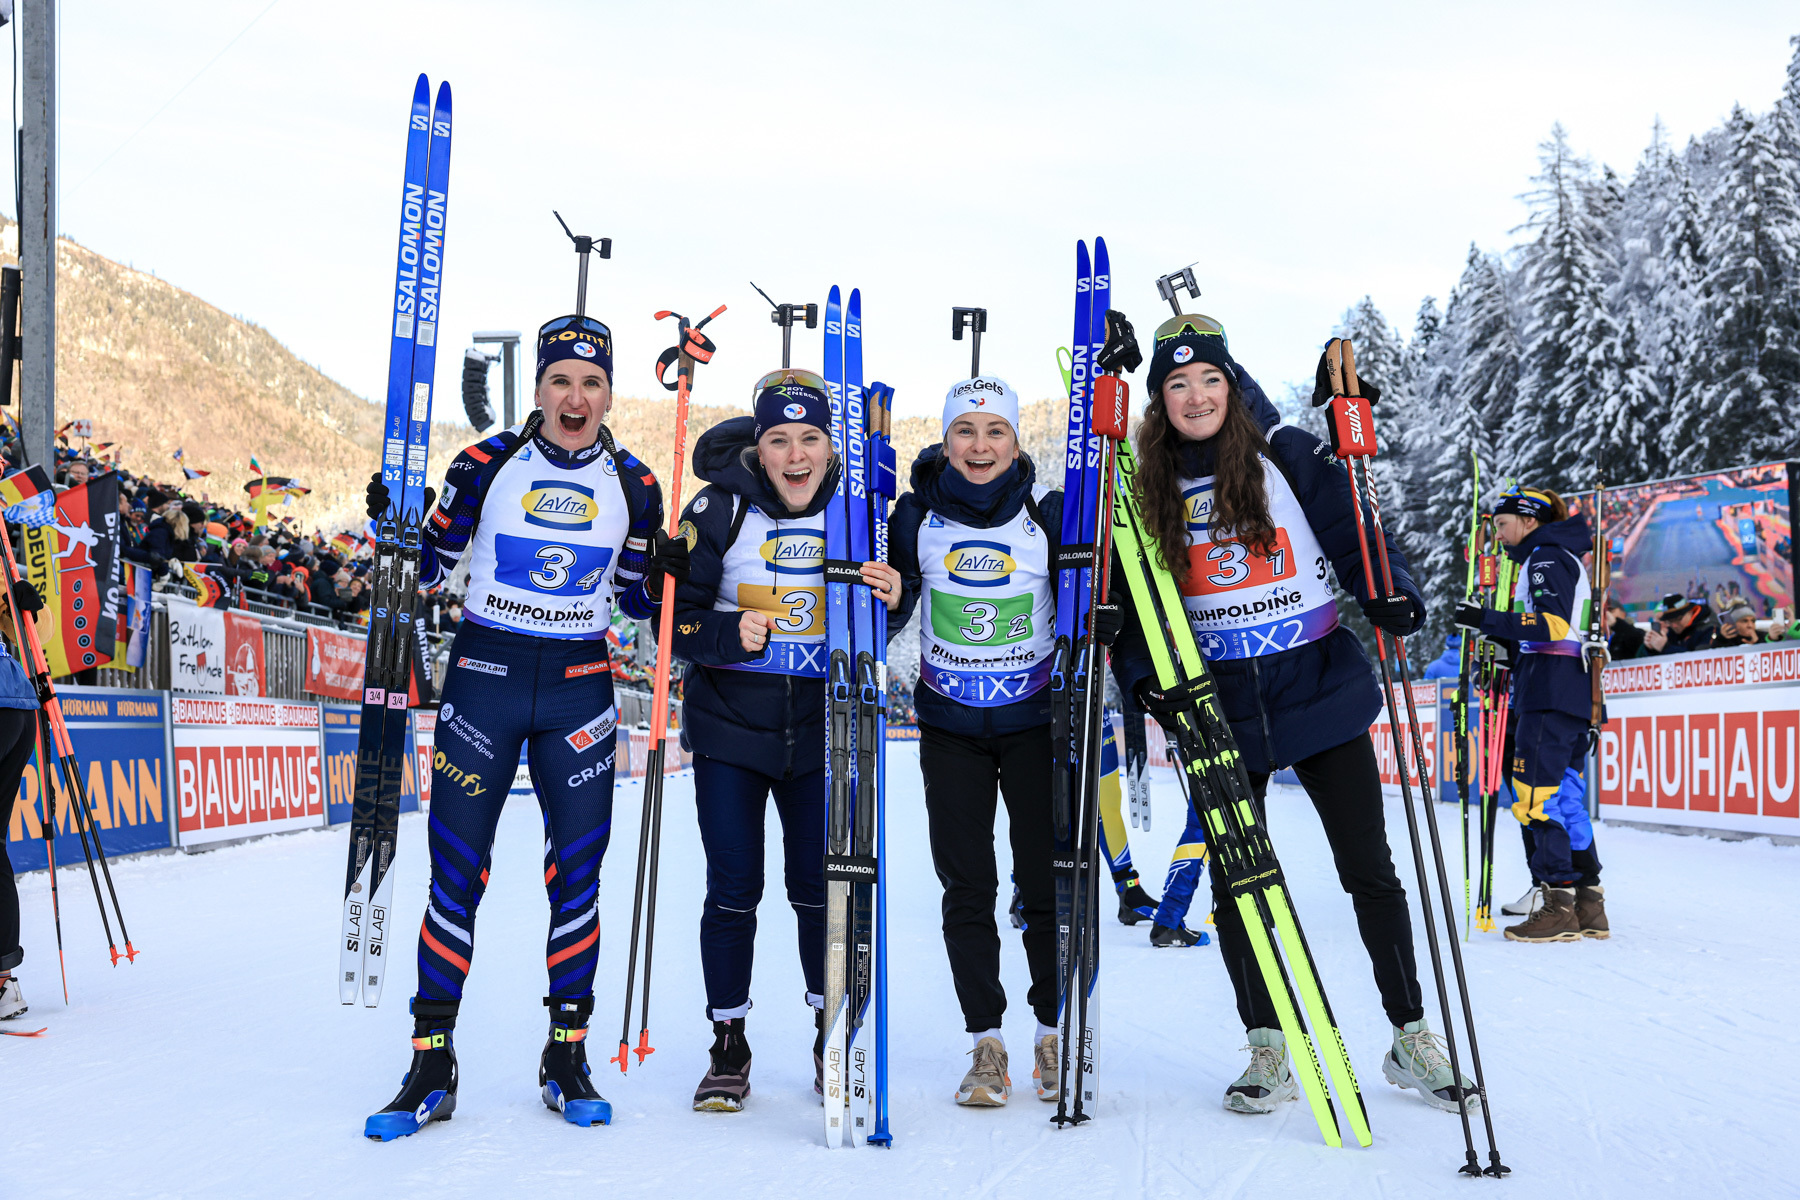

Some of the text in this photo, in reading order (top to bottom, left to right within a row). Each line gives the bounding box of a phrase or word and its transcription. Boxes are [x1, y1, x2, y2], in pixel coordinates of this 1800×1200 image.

[397, 183, 424, 314] SALOMON
[420, 190, 446, 322] SALOMON
[547, 331, 611, 356] somfy
[953, 382, 972, 398] Les
[973, 379, 1004, 396] Gets
[1068, 345, 1088, 469] SALOMON
[1114, 380, 1124, 432] SWIX
[1345, 400, 1365, 447] SWIX
[848, 384, 866, 499] SALOMON
[407, 475, 423, 487] 52
[1362, 454, 1382, 532] SWIX
[529, 545, 605, 590] 3 4
[1058, 552, 1093, 560] SALOMO
[1206, 542, 1285, 587] 3 1
[1315, 556, 1326, 580] 3
[827, 567, 861, 576] SALOM
[483, 607, 554, 627] BAYERISCHE
[486, 593, 594, 621] RUHPOLDING
[774, 590, 818, 633] 3
[1190, 591, 1302, 622] RUHPOLDING
[1267, 603, 1304, 617] ALPEN
[170, 621, 213, 649] Biathlon
[960, 601, 1030, 643] 3 2
[415, 617, 433, 681] BIATHLON
[1241, 619, 1310, 658] iX2
[467, 660, 507, 673] Jean Lain
[789, 643, 826, 672] iX
[931, 656, 994, 668] BAYERISCHE
[1605, 665, 1662, 693] BAUHAUS
[1675, 657, 1744, 687] BAUHAUS
[370, 691, 381, 701] 3/4
[392, 695, 403, 706] 3/4
[979, 673, 1030, 701] iX2
[62, 699, 108, 716] HÖRMANN
[117, 700, 158, 716] HÖRMANN
[179, 700, 227, 724] BAUHAUS
[234, 702, 276, 725] BAUHAUS
[283, 705, 318, 726] BAUHAUS
[448, 721, 495, 760] Rhône-Alpes
[455, 715, 493, 746] Auvergne-
[590, 718, 610, 735] CAISSE
[567, 749, 616, 787] CRAFT
[1601, 726, 1796, 803] BAUHAU
[9, 758, 164, 842] RMANN
[179, 755, 321, 819] BAUHAUS
[827, 864, 875, 875] SALOMON
[1231, 868, 1277, 888] FISCHER
